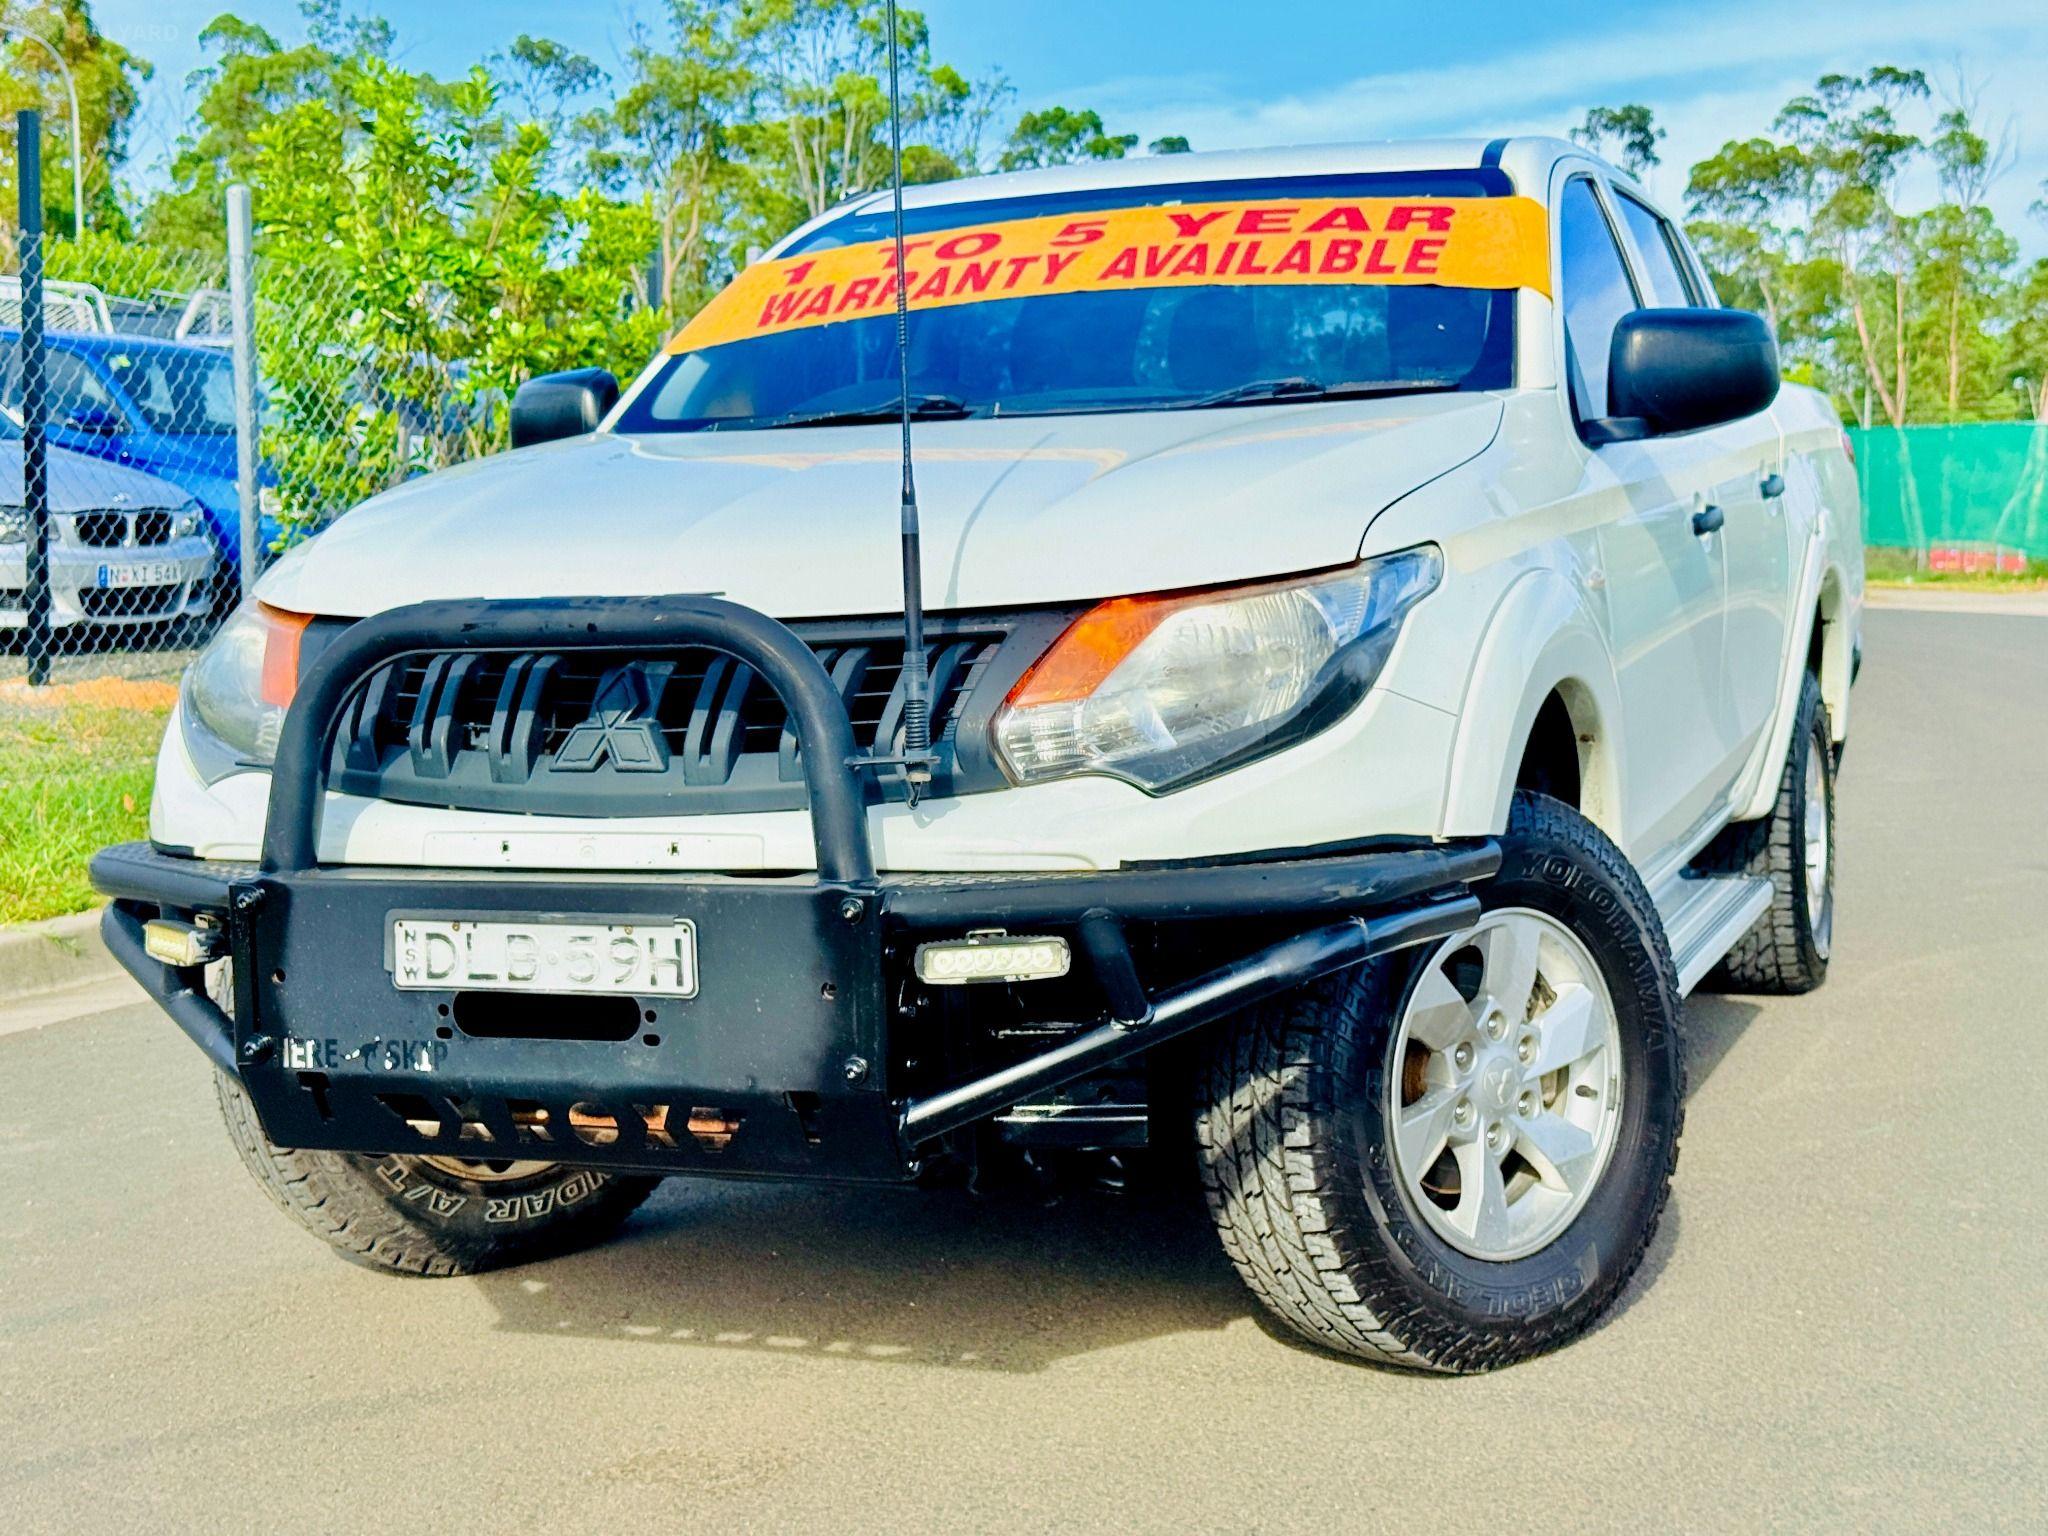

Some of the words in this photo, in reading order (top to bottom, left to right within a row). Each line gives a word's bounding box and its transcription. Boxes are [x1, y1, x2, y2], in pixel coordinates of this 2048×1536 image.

[756, 251, 1085, 328] WARRANTY
[1095, 238, 1448, 282] AVAILABLE
[783, 260, 817, 287] 1
[878, 232, 1003, 271] TO
[1049, 220, 1109, 248] 5
[1166, 206, 1457, 239] YEAR
